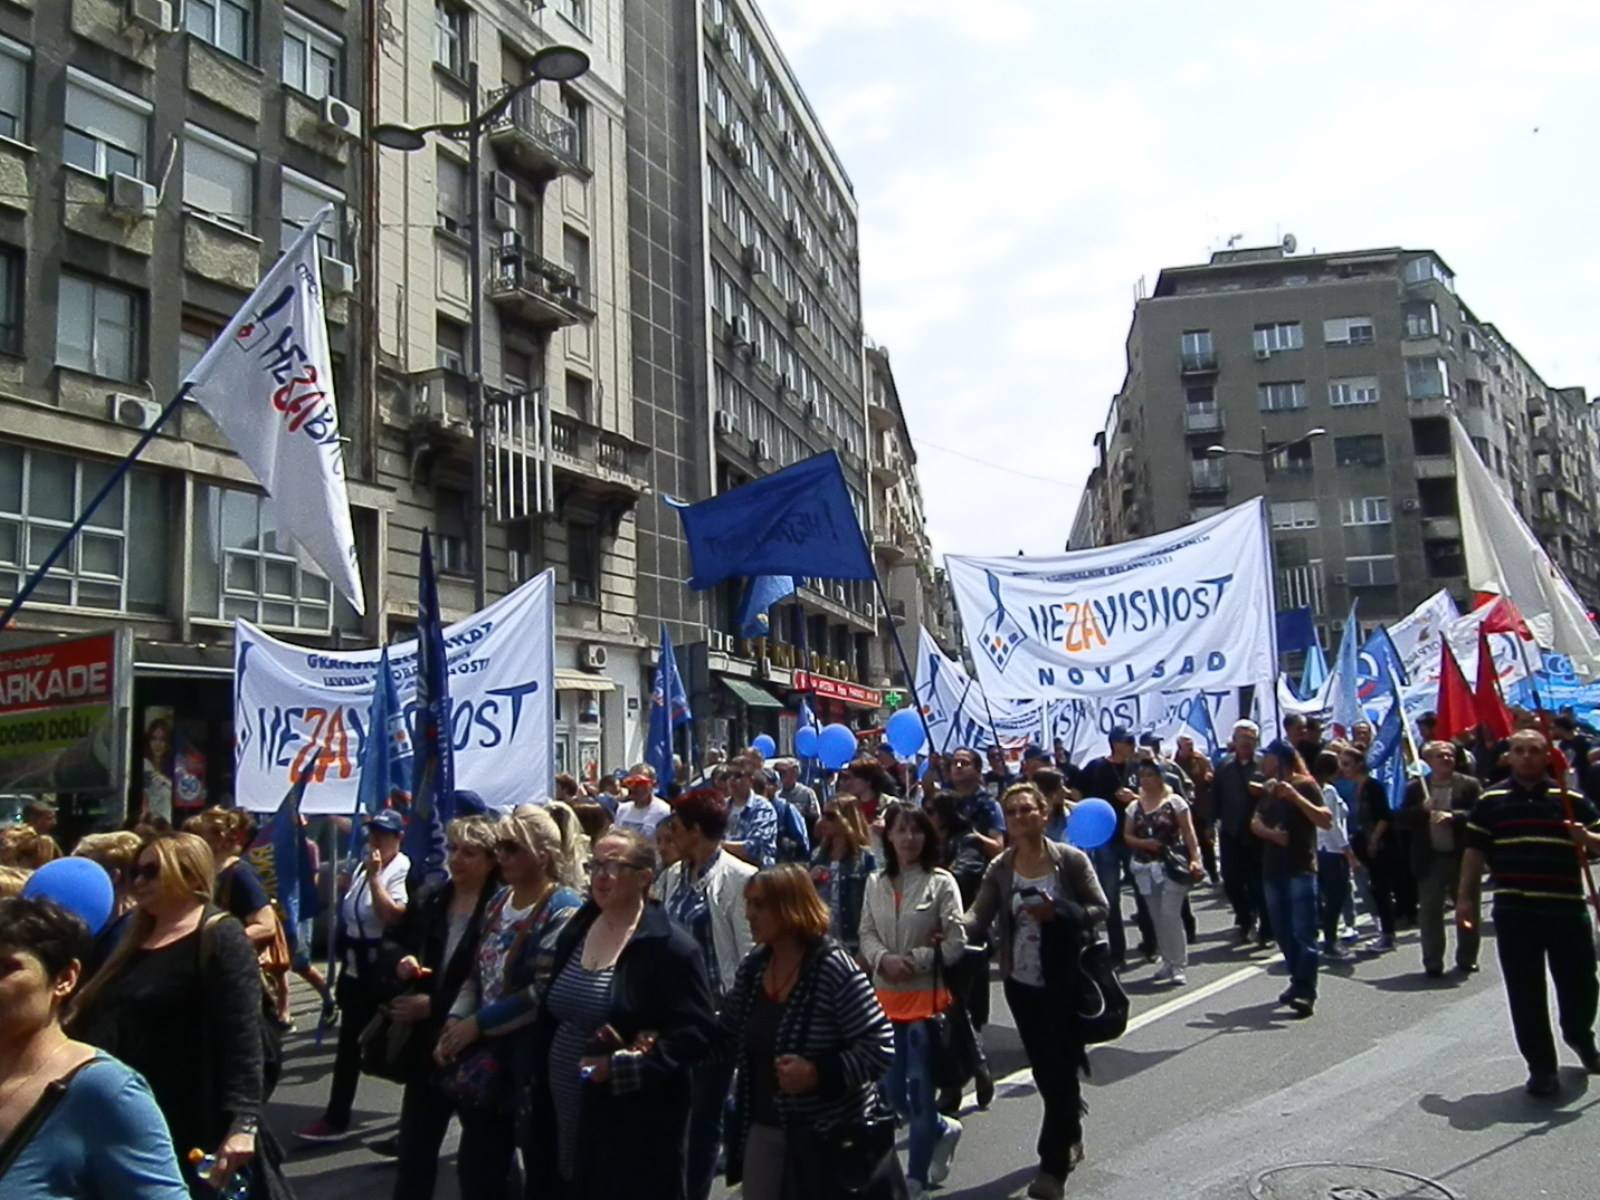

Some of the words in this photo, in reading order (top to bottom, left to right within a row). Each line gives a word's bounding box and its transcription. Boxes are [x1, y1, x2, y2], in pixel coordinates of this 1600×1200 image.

[1029, 573, 1233, 652] NEZAVISNOST
[1038, 663, 1135, 686] NOVI
[1151, 651, 1226, 679] SAD
[258, 680, 539, 783] NEZAVOST
